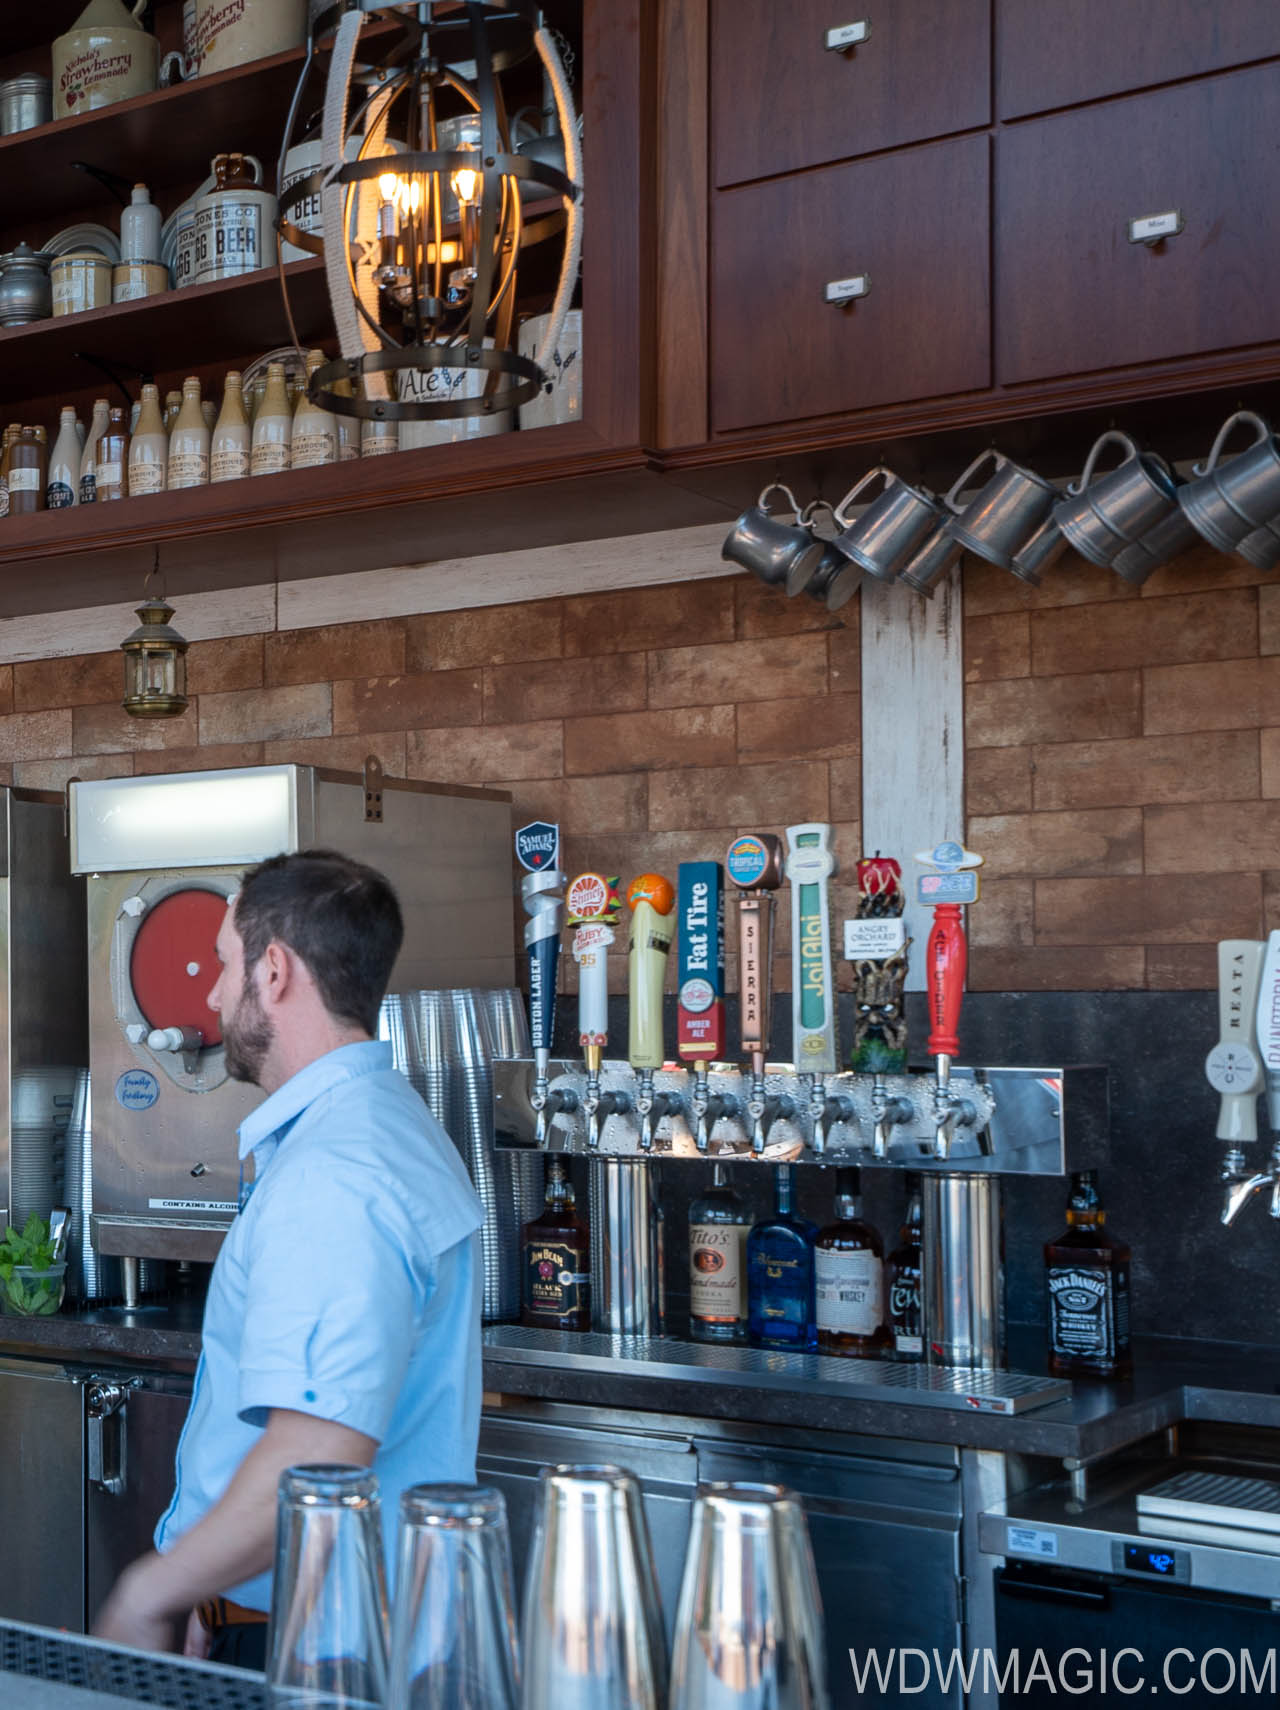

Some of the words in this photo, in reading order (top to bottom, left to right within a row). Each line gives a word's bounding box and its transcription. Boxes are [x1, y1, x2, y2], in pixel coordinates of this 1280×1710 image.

[60, 54, 131, 91] Strawberry
[84, 65, 128, 85] Lemonade
[295, 192, 322, 220] BEE
[196, 209, 229, 226] JONES
[180, 231, 195, 244] JON
[216, 227, 256, 255] BEER
[519, 833, 555, 846] SAMUEL
[521, 841, 553, 855] ADAMS
[687, 882, 708, 931] Tire
[851, 932, 896, 942] ORCHARD
[858, 925, 888, 933] ANGRY
[687, 937, 708, 971] Fat
[746, 926, 756, 1022] SIERRA
[802, 962, 824, 996] Jai
[1230, 953, 1244, 1029] REATA
[686, 1019, 710, 1029] AMBER
[692, 1027, 706, 1038] ALE
[162, 1200, 206, 1209] CONTAINS
[208, 1203, 239, 1211] ALCOH
[690, 1229, 730, 1246] Tito's
[1049, 1275, 1070, 1293] JACK
